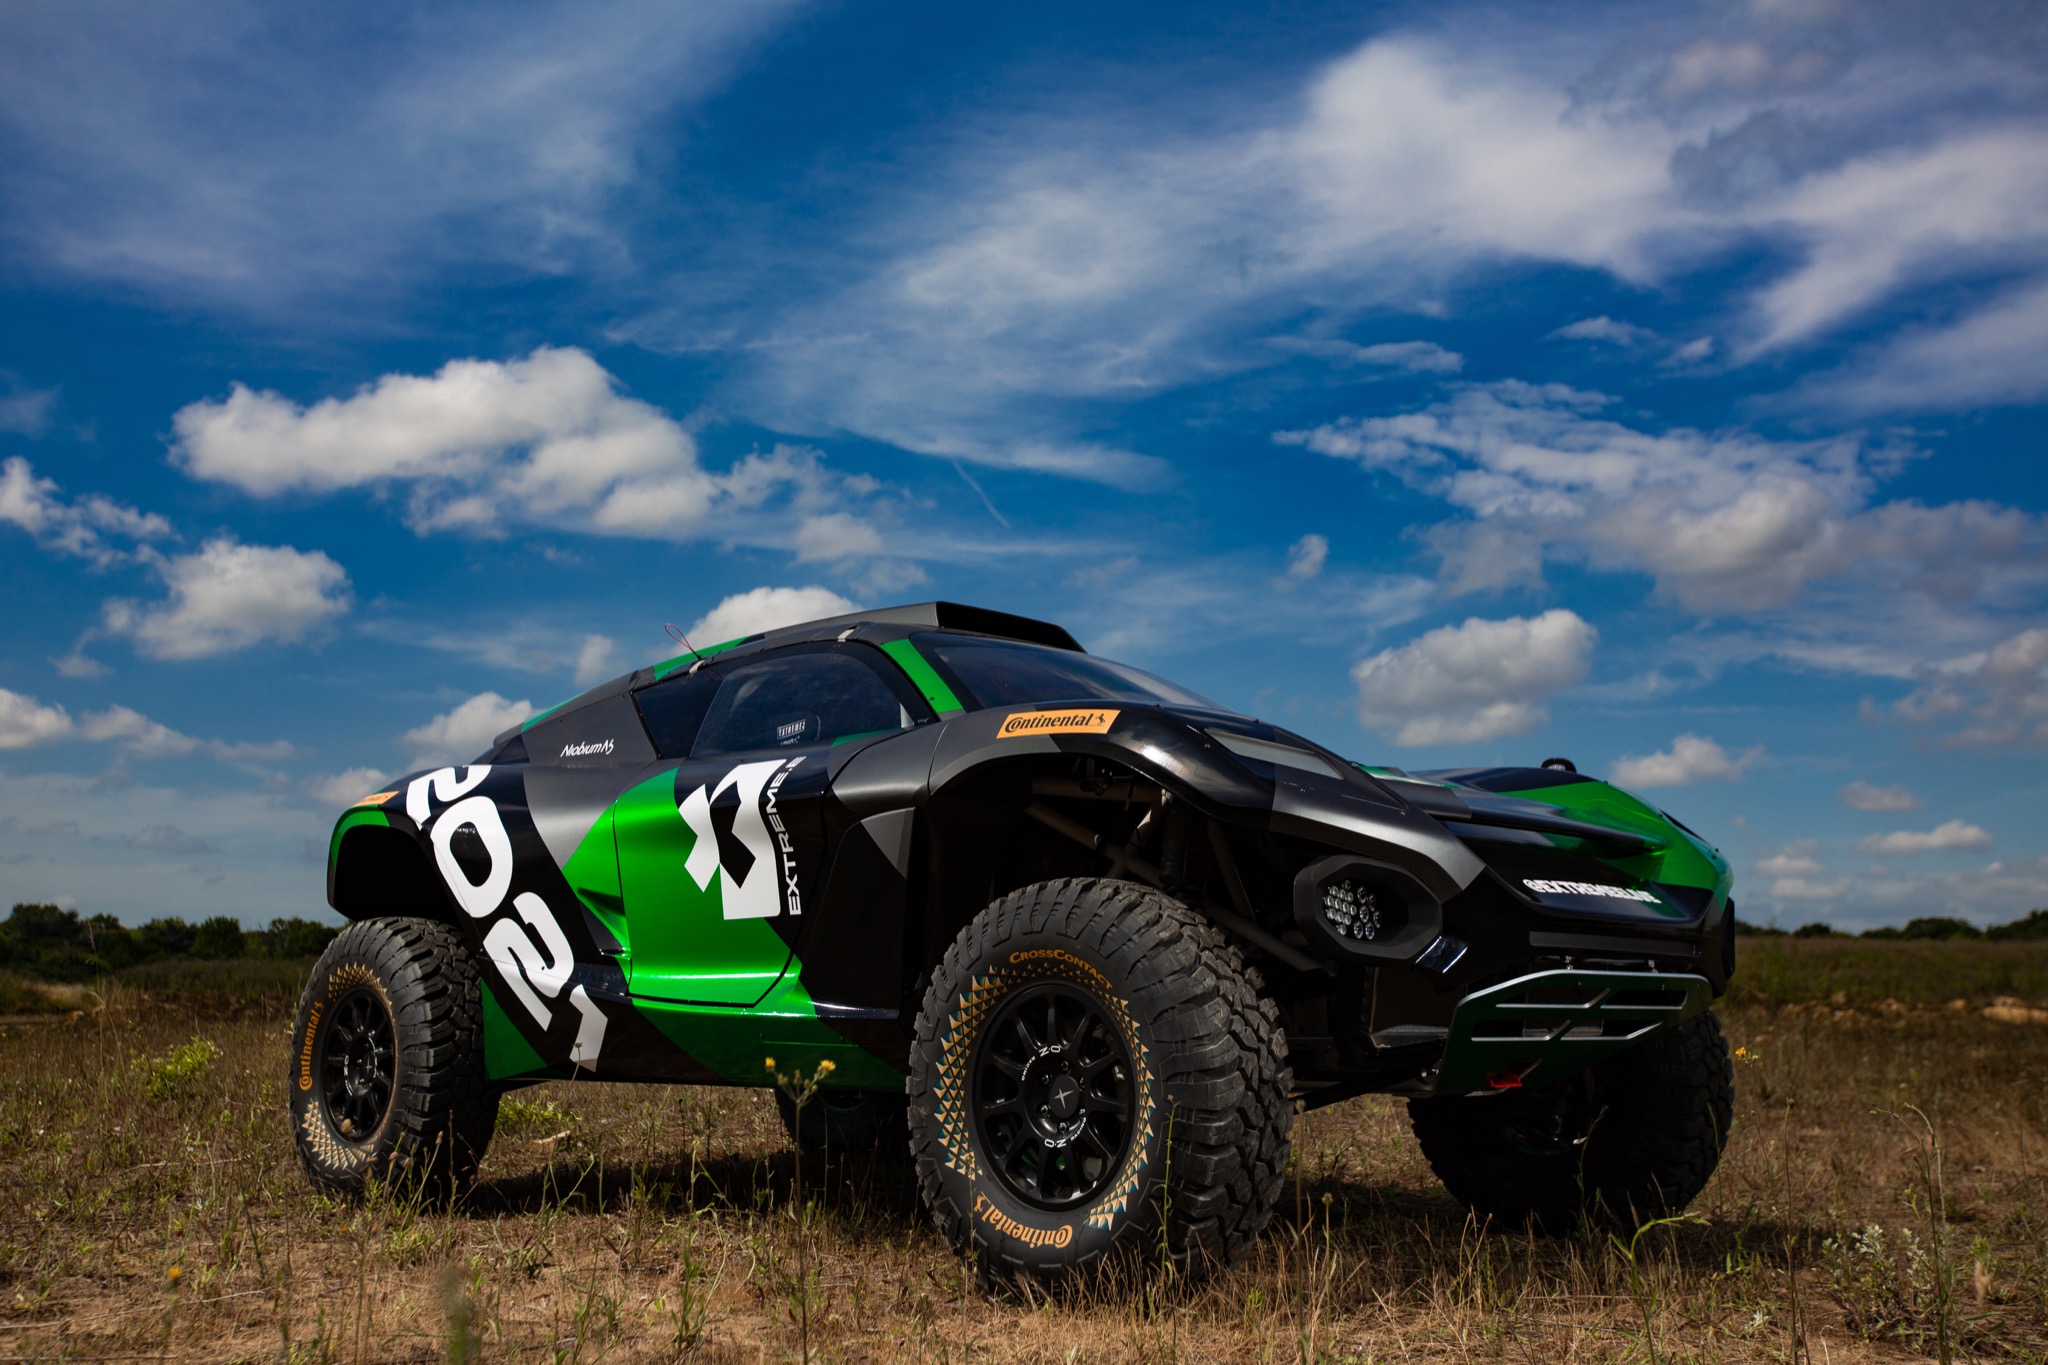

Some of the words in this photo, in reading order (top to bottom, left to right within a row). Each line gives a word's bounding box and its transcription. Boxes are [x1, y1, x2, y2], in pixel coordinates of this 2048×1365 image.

[1004, 713, 1094, 733] Continental
[299, 1009, 321, 1091] Continental
[981, 1203, 1073, 1249] Continental
